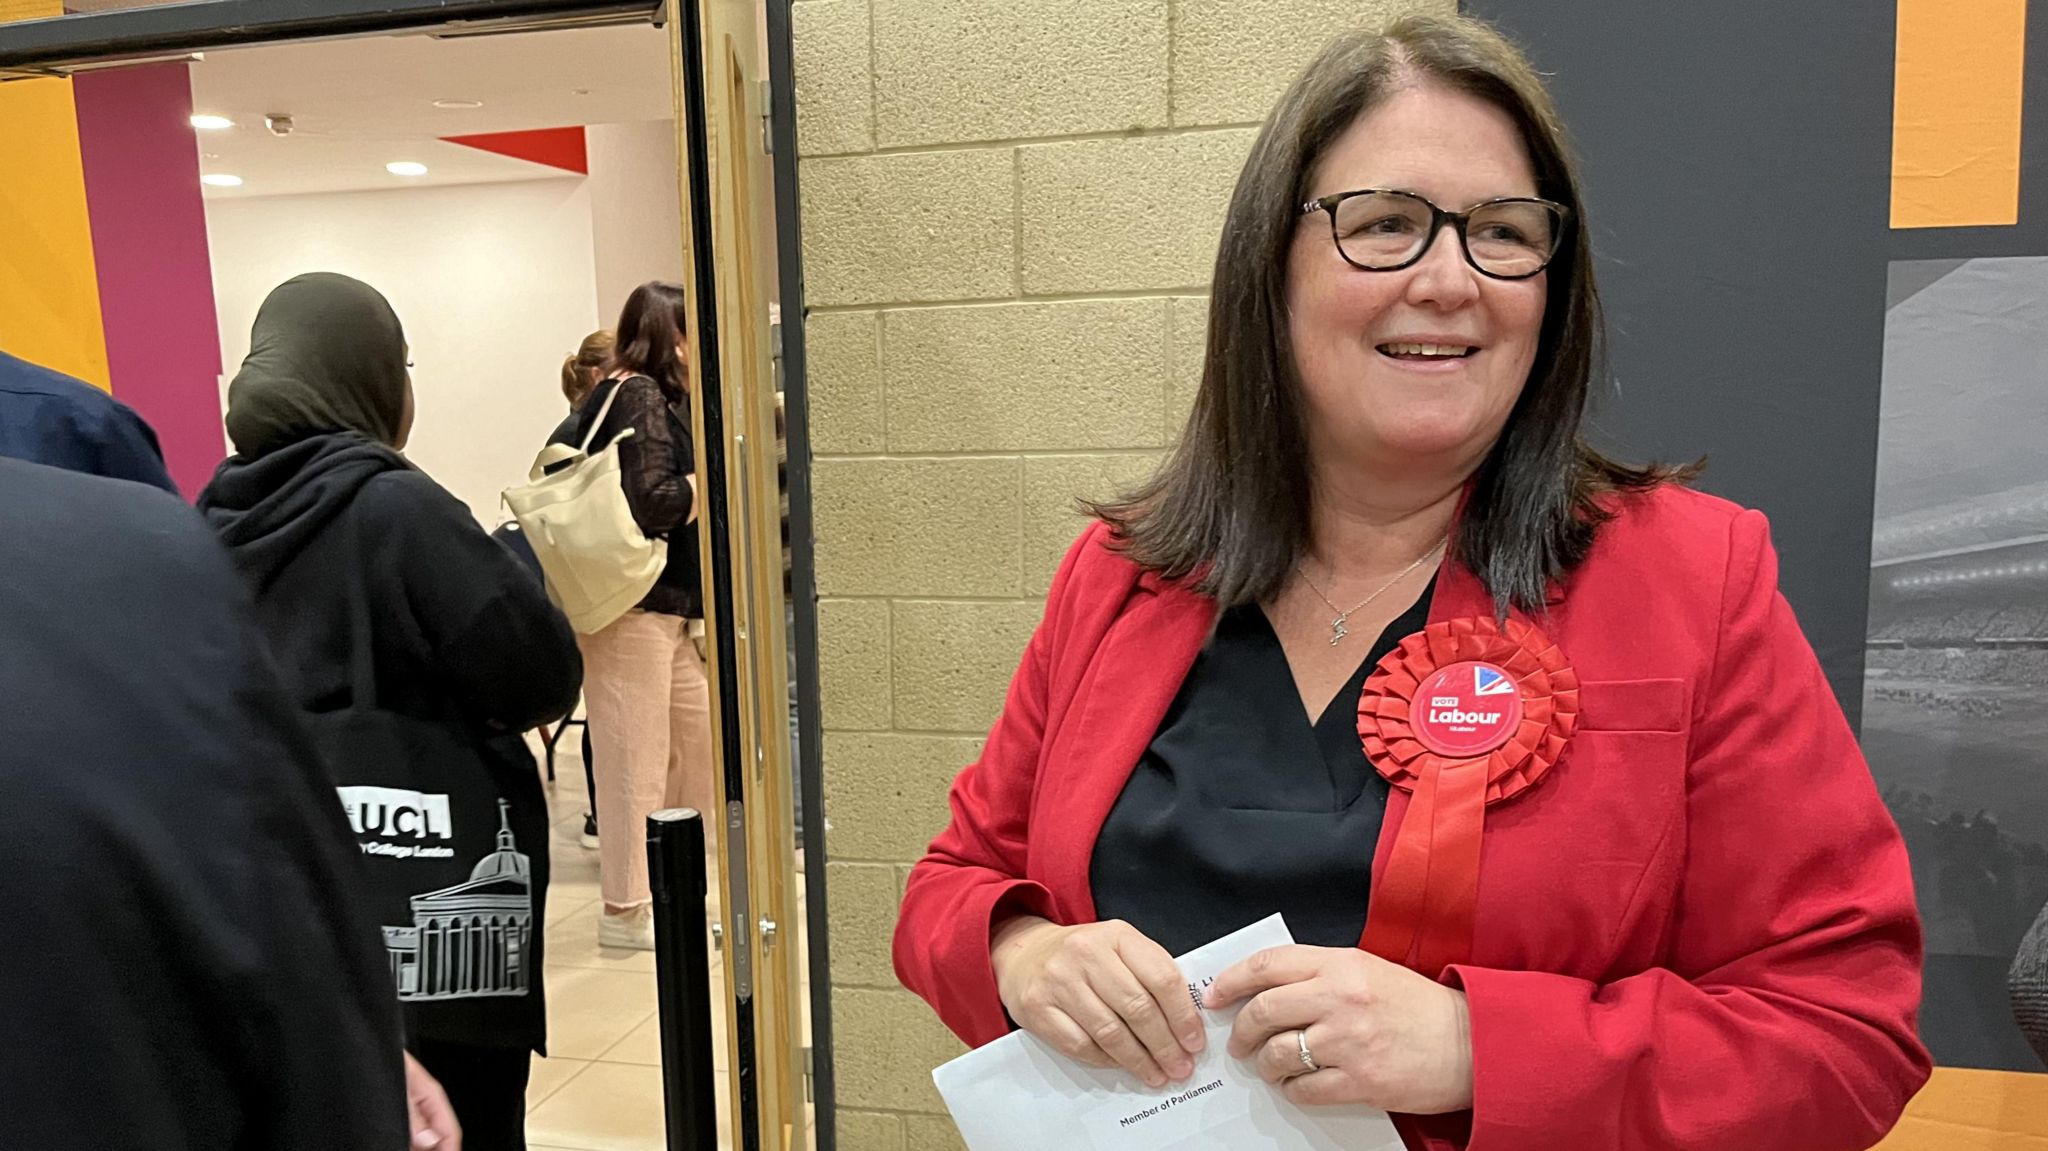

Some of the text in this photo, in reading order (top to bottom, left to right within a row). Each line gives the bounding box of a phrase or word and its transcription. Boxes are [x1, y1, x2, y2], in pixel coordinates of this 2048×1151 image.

[1429, 708, 1501, 725] Labour
[361, 803, 441, 839] UCL
[367, 841, 413, 859] College
[413, 845, 454, 858] London
[1119, 1079, 1224, 1127] Member of Parliament
